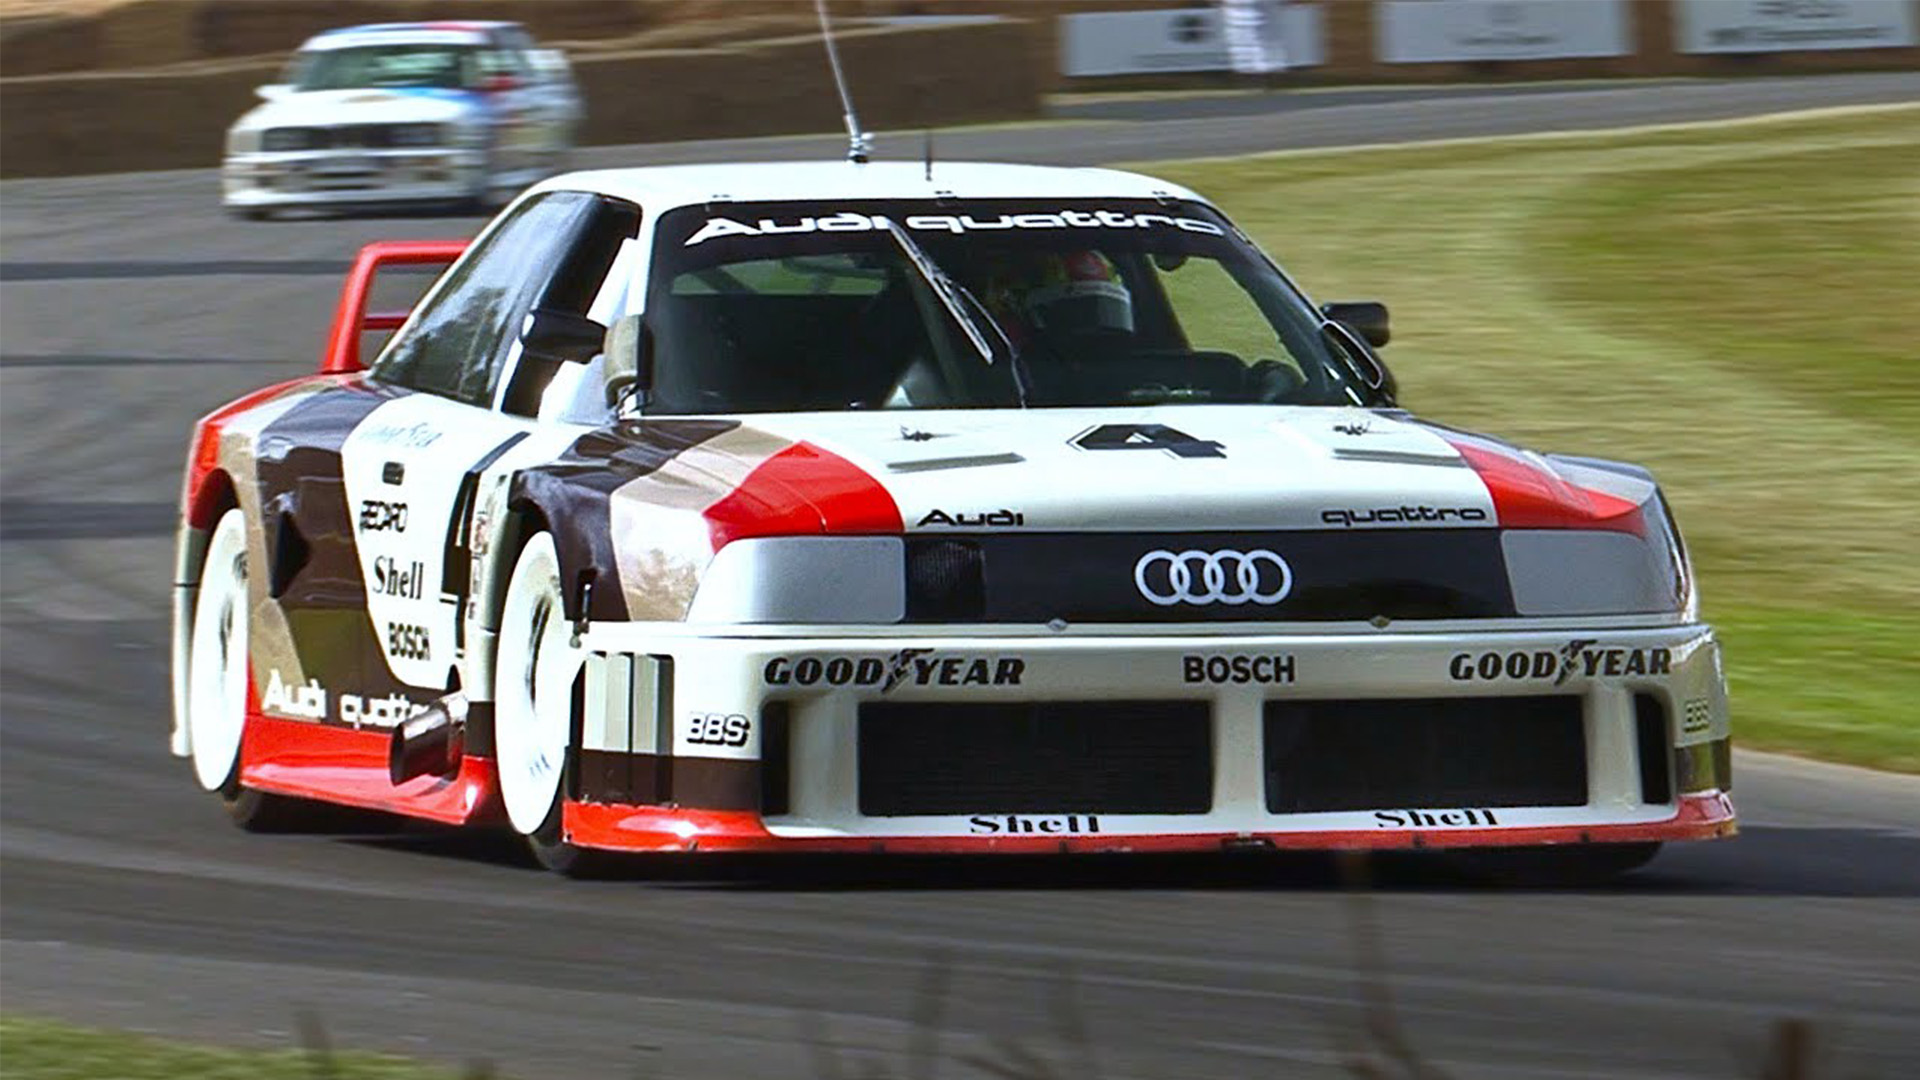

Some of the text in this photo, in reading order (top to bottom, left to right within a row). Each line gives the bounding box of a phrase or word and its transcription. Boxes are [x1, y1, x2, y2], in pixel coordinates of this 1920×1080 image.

[684, 210, 1224, 247] Audi quattro
[1066, 423, 1228, 460] 4
[916, 509, 1023, 527] Audi
[1321, 506, 1486, 526] quattro
[372, 554, 424, 600] Shell
[388, 621, 431, 661] BOSCH
[1183, 655, 1295, 684] BOSCH
[261, 669, 431, 731] Audi quattr
[687, 711, 751, 747] BBS
[970, 814, 1100, 835] Shell
[1374, 808, 1499, 829] Shell
